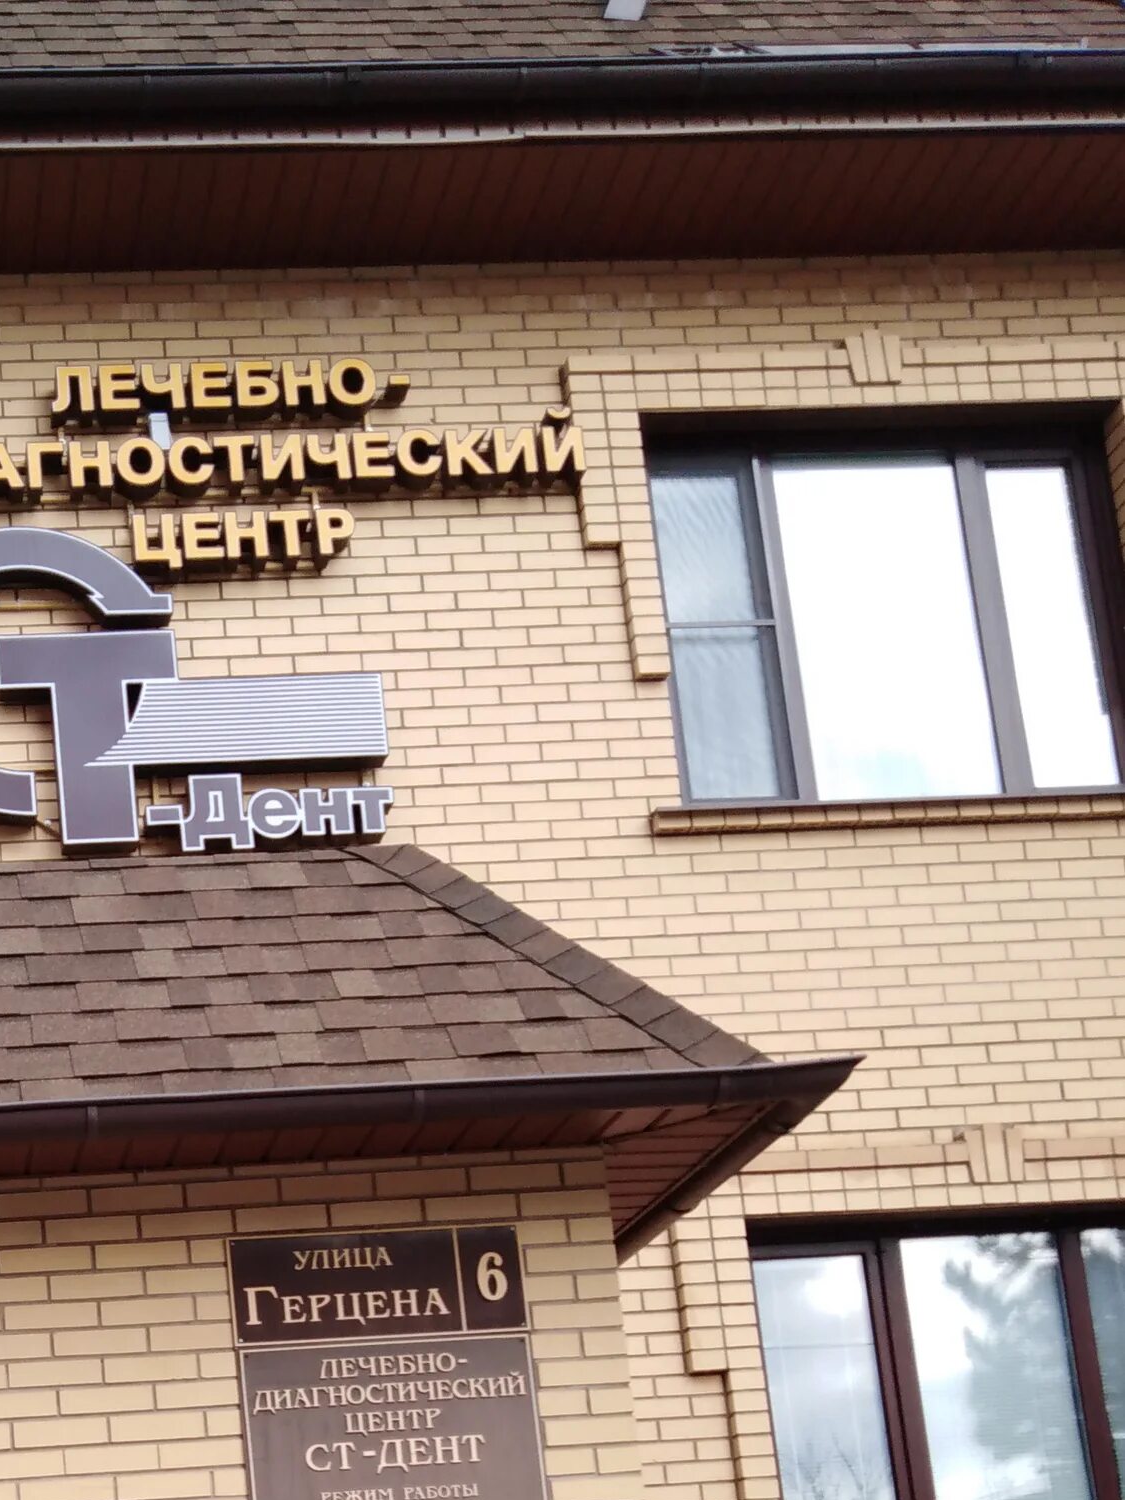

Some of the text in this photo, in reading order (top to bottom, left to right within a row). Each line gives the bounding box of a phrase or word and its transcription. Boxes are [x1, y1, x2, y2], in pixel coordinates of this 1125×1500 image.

[52, 358, 411, 414] ЛЕЧЕБНО-
[133, 508, 355, 568] ЦЕНТР
[292, 1246, 394, 1271] УЛИЦА
[476, 1251, 509, 1301] 6
[319, 1352, 469, 1380] ЛЕЧЕБНО-
[252, 1371, 527, 1416] ДИАГНОСТИЧЕСКИЙ
[344, 1407, 442, 1437] ЦЕНТР
[403, 1483, 480, 1500] РАБОТЫ
